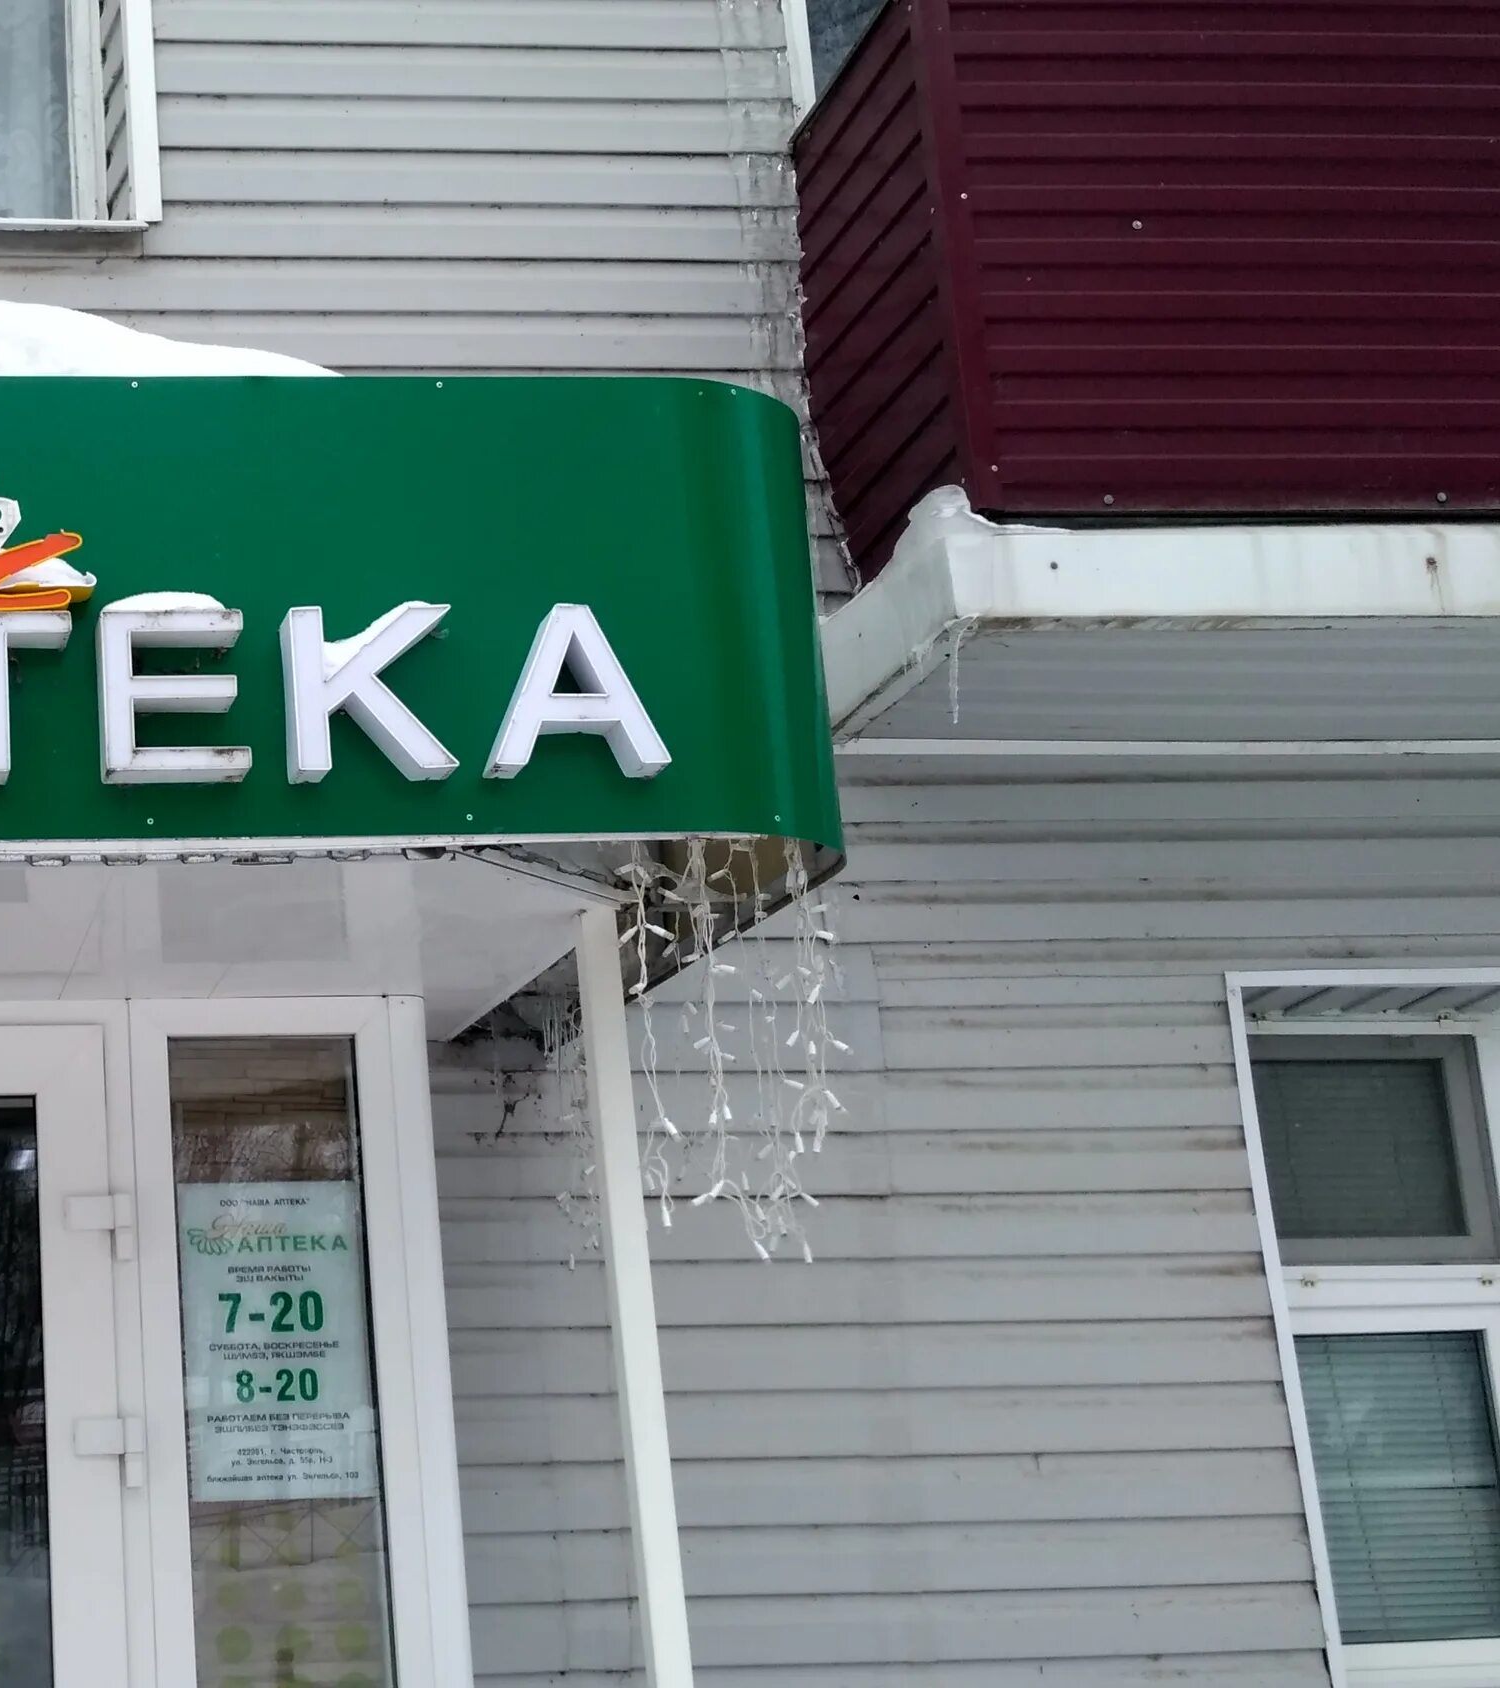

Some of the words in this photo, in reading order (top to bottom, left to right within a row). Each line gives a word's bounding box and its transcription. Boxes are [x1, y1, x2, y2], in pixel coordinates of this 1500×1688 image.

[237, 1234, 348, 1253] АПТЕКА
[227, 1265, 265, 1274] ВРЕМЯ
[266, 1265, 311, 1274] РАБОТЫ
[256, 1274, 304, 1282] ВАКЫТЫ
[218, 1290, 324, 1333] 7-20
[263, 1341, 340, 1350] ВОСКРЕСЕНЬЕ
[236, 1368, 319, 1403] 8-20
[207, 1414, 267, 1423] РАБОТАЕМ
[269, 1413, 290, 1422] БЕЗ
[292, 1412, 350, 1421] ПЕРЕРЫВА
